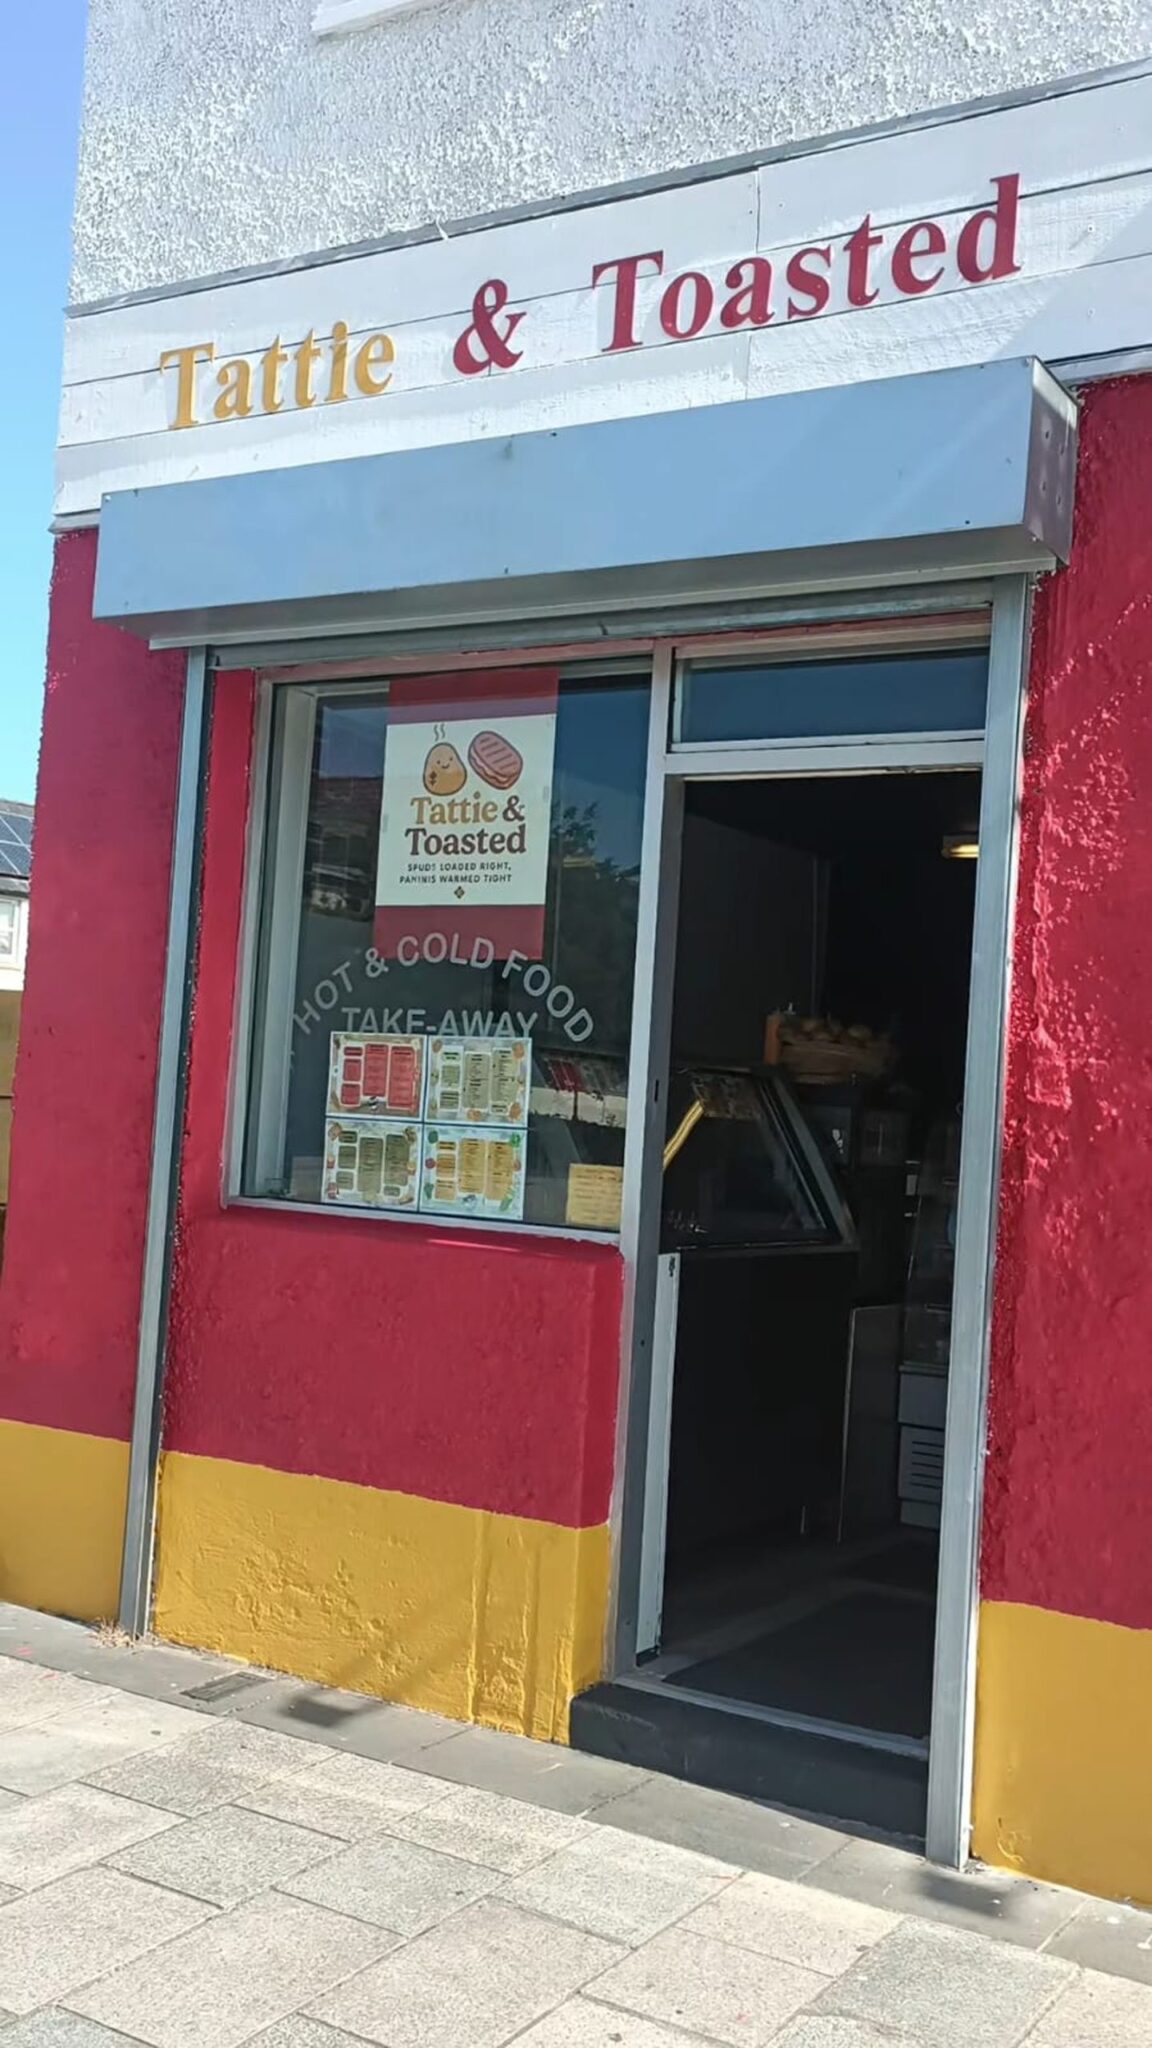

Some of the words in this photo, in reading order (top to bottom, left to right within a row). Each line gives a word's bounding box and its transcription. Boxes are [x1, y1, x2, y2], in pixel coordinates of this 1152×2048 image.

[159, 321, 395, 431] Tattie
[453, 278, 528, 376] &
[592, 172, 1022, 353] Toasted
[411, 791, 499, 825] Tattie
[502, 795, 526, 823] &
[404, 824, 528, 856] Toasted
[399, 874, 436, 884] PANINIS
[439, 874, 481, 884] WARMED
[484, 873, 512, 883] TIGHT
[440, 862, 477, 872] LOADED
[480, 861, 512, 871] RIGHT,
[292, 960, 353, 1035] HOT
[365, 947, 389, 978] &
[397, 932, 494, 969] COLD
[501, 949, 594, 1042] FOOD
[341, 1007, 538, 1037] TAKE-AWAY
